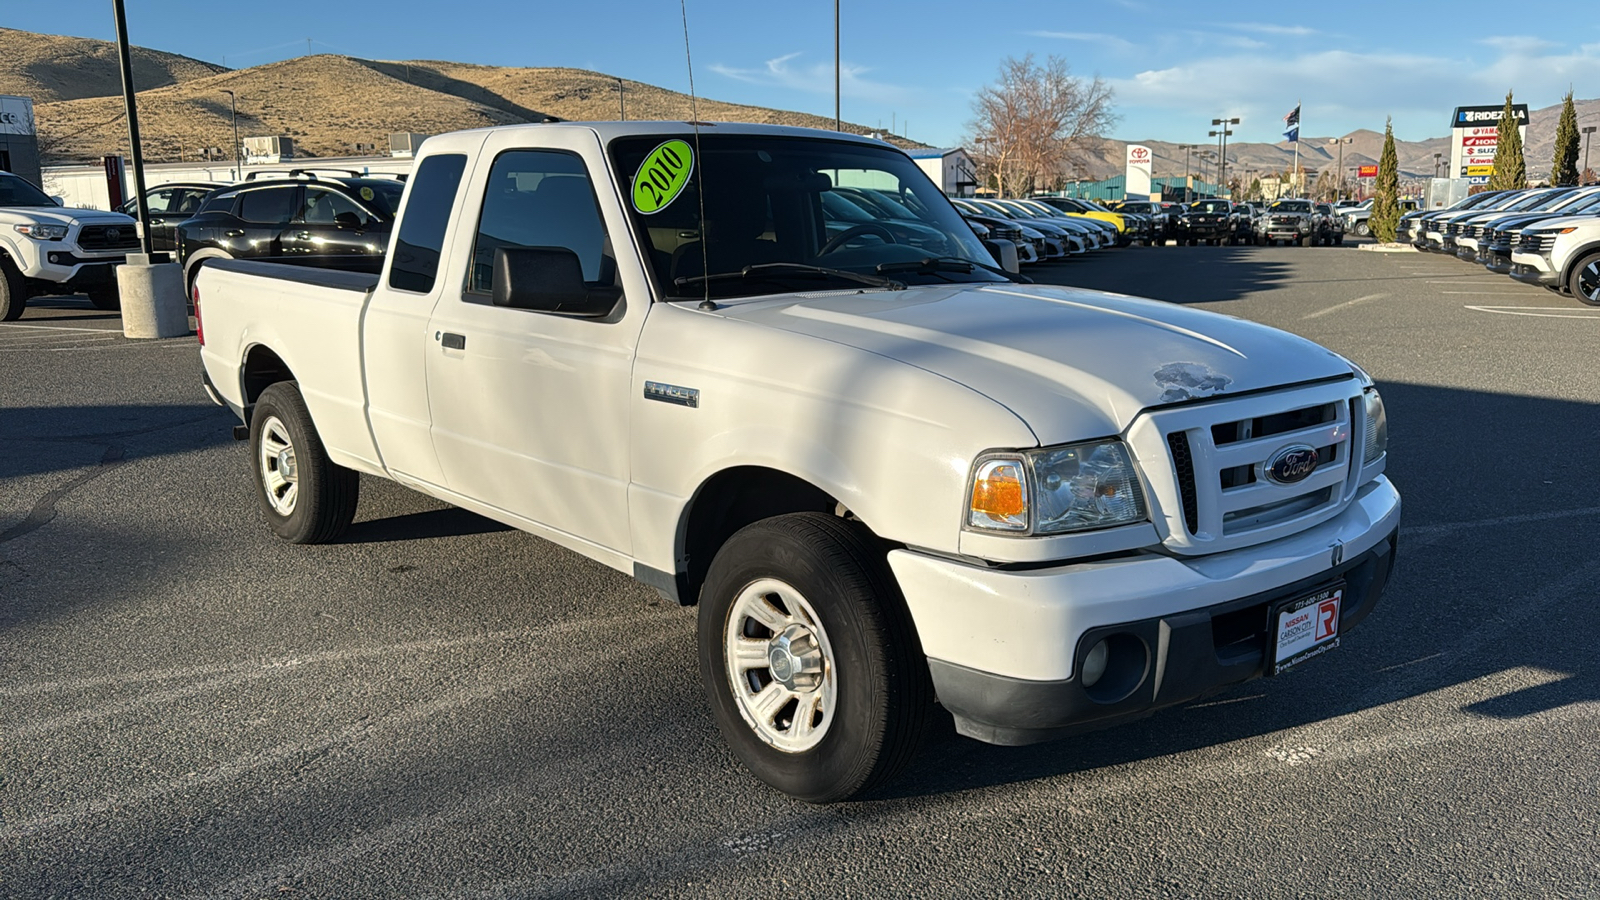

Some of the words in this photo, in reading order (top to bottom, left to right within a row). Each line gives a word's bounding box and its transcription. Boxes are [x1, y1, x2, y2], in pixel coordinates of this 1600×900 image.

[640, 146, 683, 207] 2010
[1282, 451, 1312, 477] Ford
[1280, 625, 1301, 640] CARSON
[1302, 620, 1313, 631] CITY
[1285, 613, 1309, 629] NISSAN
